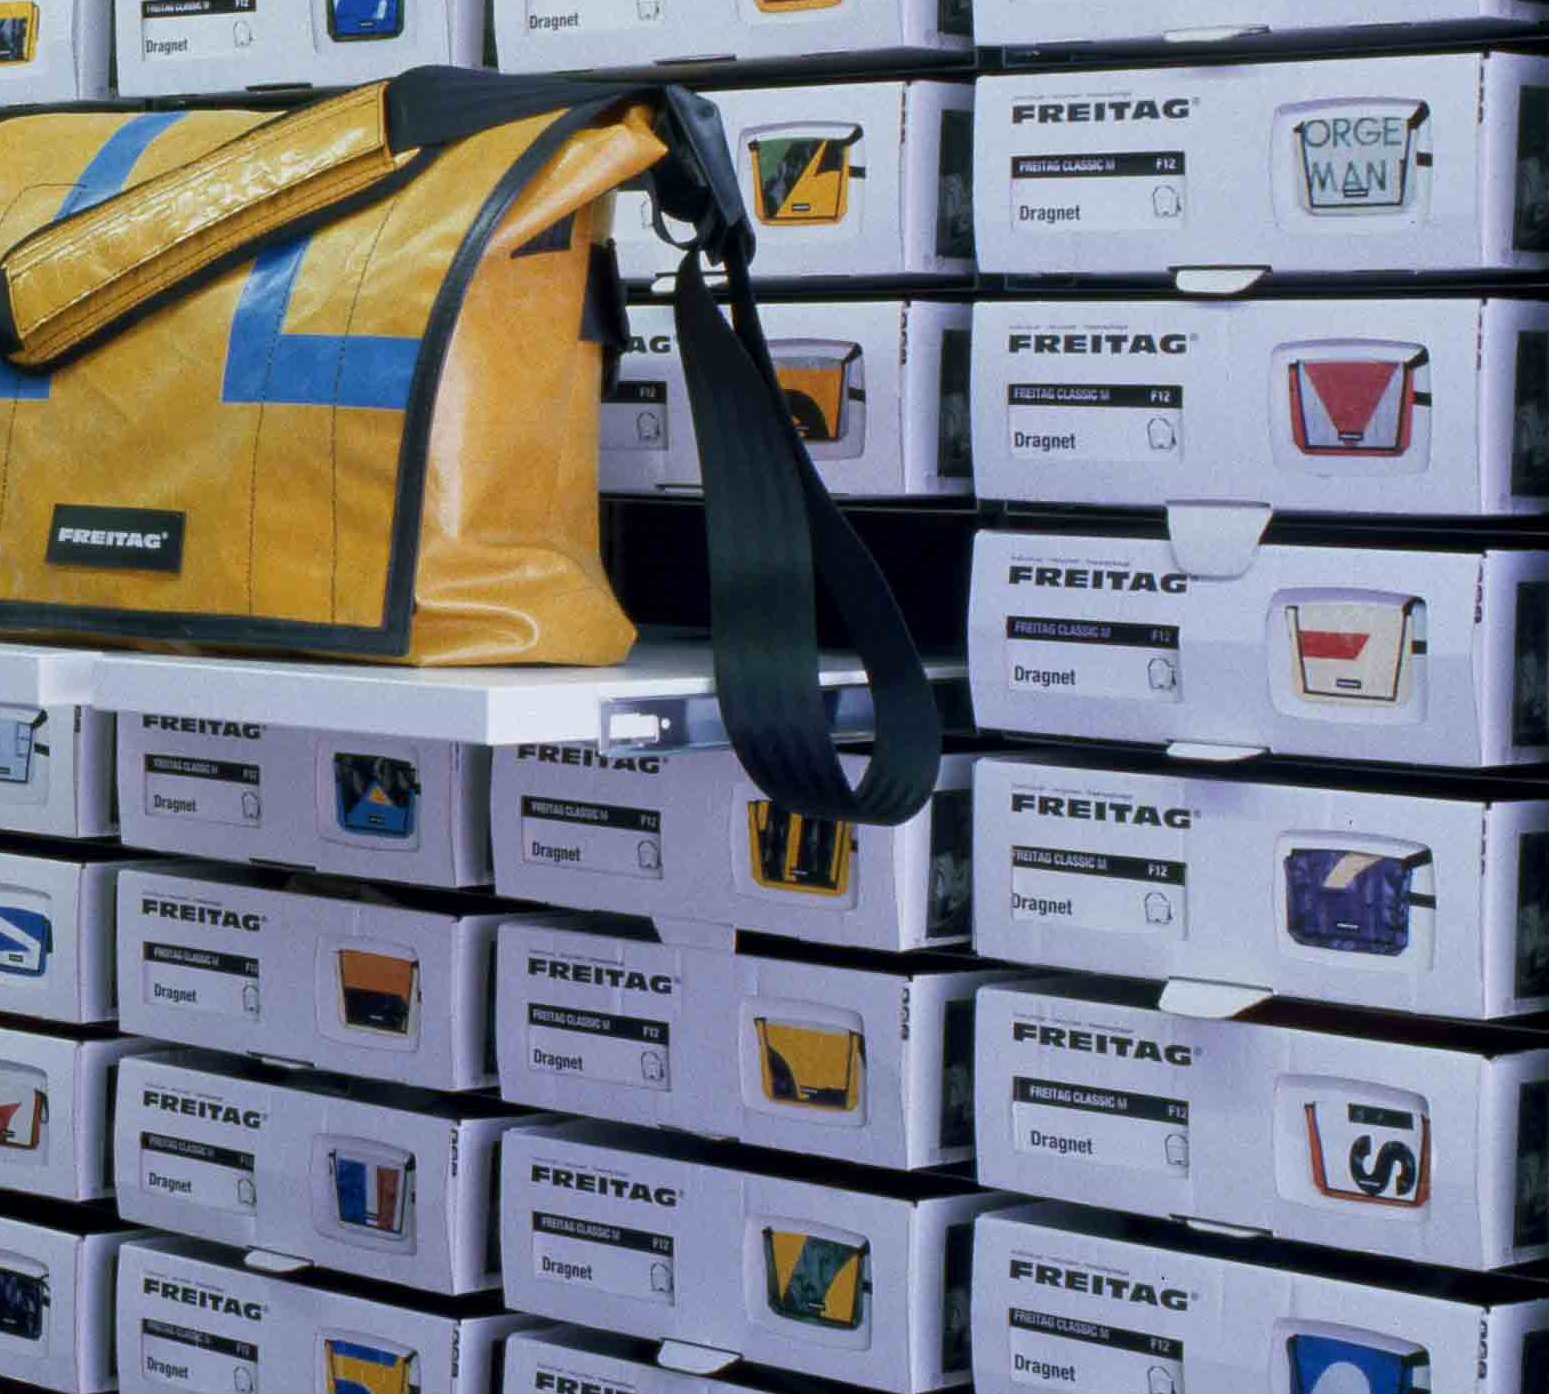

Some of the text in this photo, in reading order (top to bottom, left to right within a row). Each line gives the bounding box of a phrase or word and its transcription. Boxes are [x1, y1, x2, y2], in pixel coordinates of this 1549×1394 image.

[528, 13, 578, 31] Dragnet
[1013, 99, 1188, 123] FREITAG
[1019, 159, 1060, 173] FREITAG
[1061, 158, 1103, 172] CLASSIC
[1156, 156, 1176, 169] F12
[1019, 205, 1080, 224] Dragnet
[1009, 334, 1186, 354] FREITAG
[1015, 432, 1075, 452] Dragnet
[59, 528, 160, 548] FREITAG
[1009, 566, 1187, 593] FREITAG
[1015, 665, 1075, 687] Dragnet
[1012, 794, 1190, 828] FREITAG
[143, 899, 260, 931] FREITAG
[1011, 892, 1072, 916] Dragnet
[529, 958, 671, 994] FREITAG
[154, 983, 196, 1002] Dragnet
[1014, 1023, 1191, 1066] FREITAG
[534, 1049, 583, 1070] Dragnet
[144, 1091, 260, 1128] FREITAG
[1031, 1130, 1092, 1154] Dragnet
[149, 1172, 191, 1193] Dragnet
[532, 1165, 675, 1206] FREITAG
[543, 1256, 592, 1280] Dragnet
[1010, 1260, 1187, 1310] FREITAG
[144, 1279, 261, 1320] FREITAG
[147, 1356, 188, 1379] Dragnet
[1015, 1354, 1075, 1381] Dragnet
